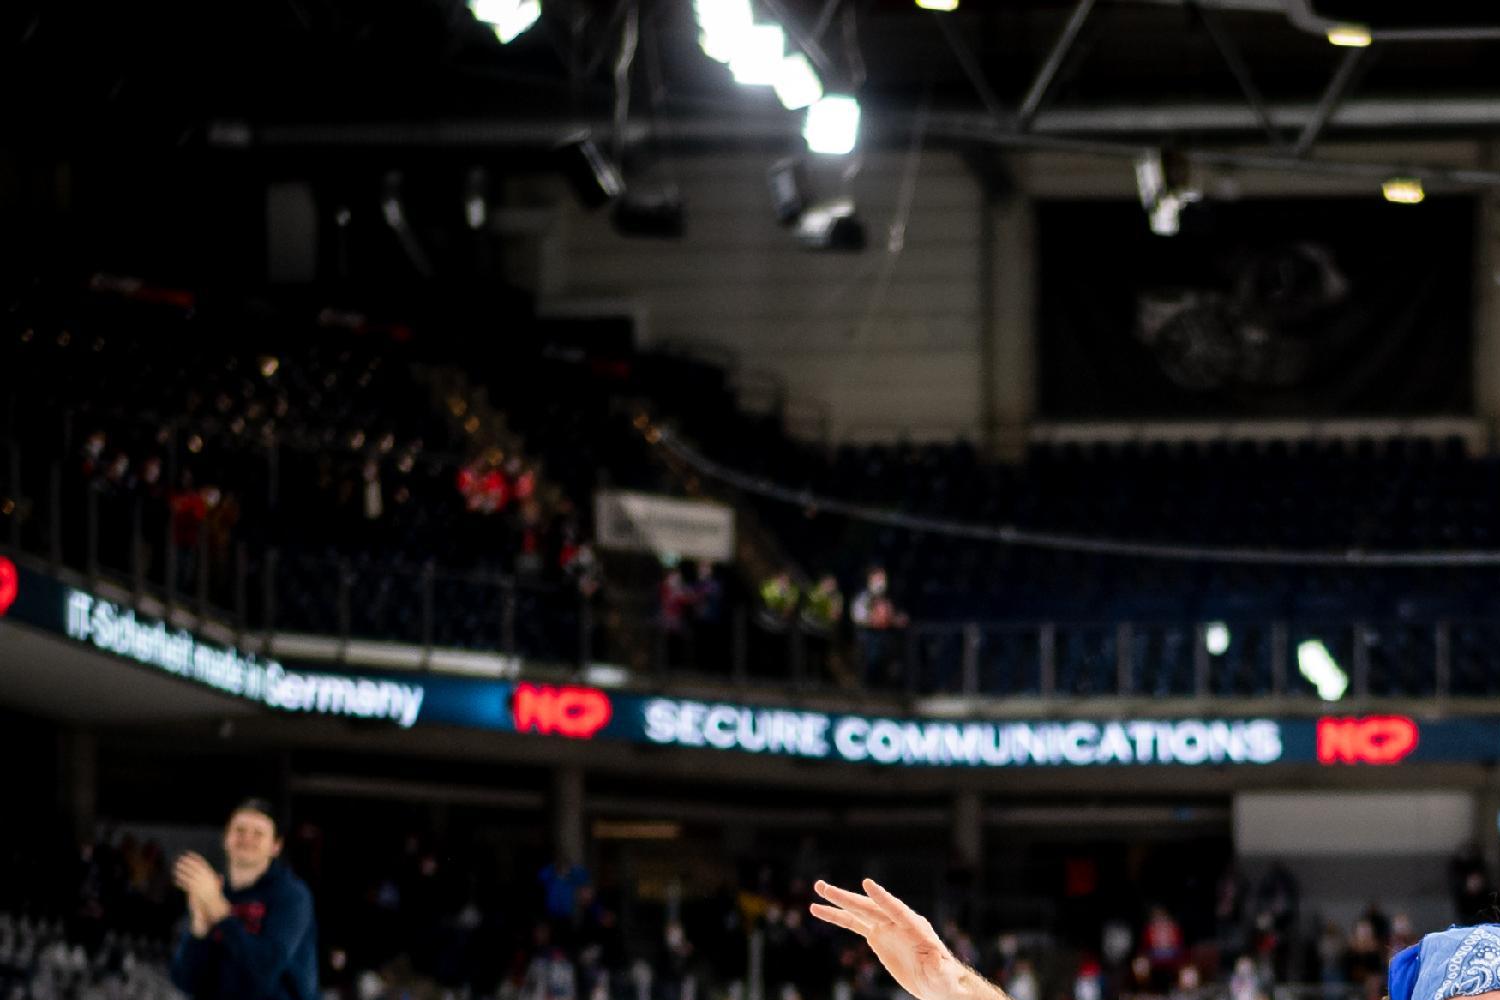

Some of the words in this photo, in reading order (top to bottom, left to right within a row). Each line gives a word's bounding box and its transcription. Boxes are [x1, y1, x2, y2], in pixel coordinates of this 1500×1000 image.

[265, 661, 424, 728] Germany
[644, 697, 830, 757] SECURE
[834, 716, 1283, 767] COMMUNICATIONS
